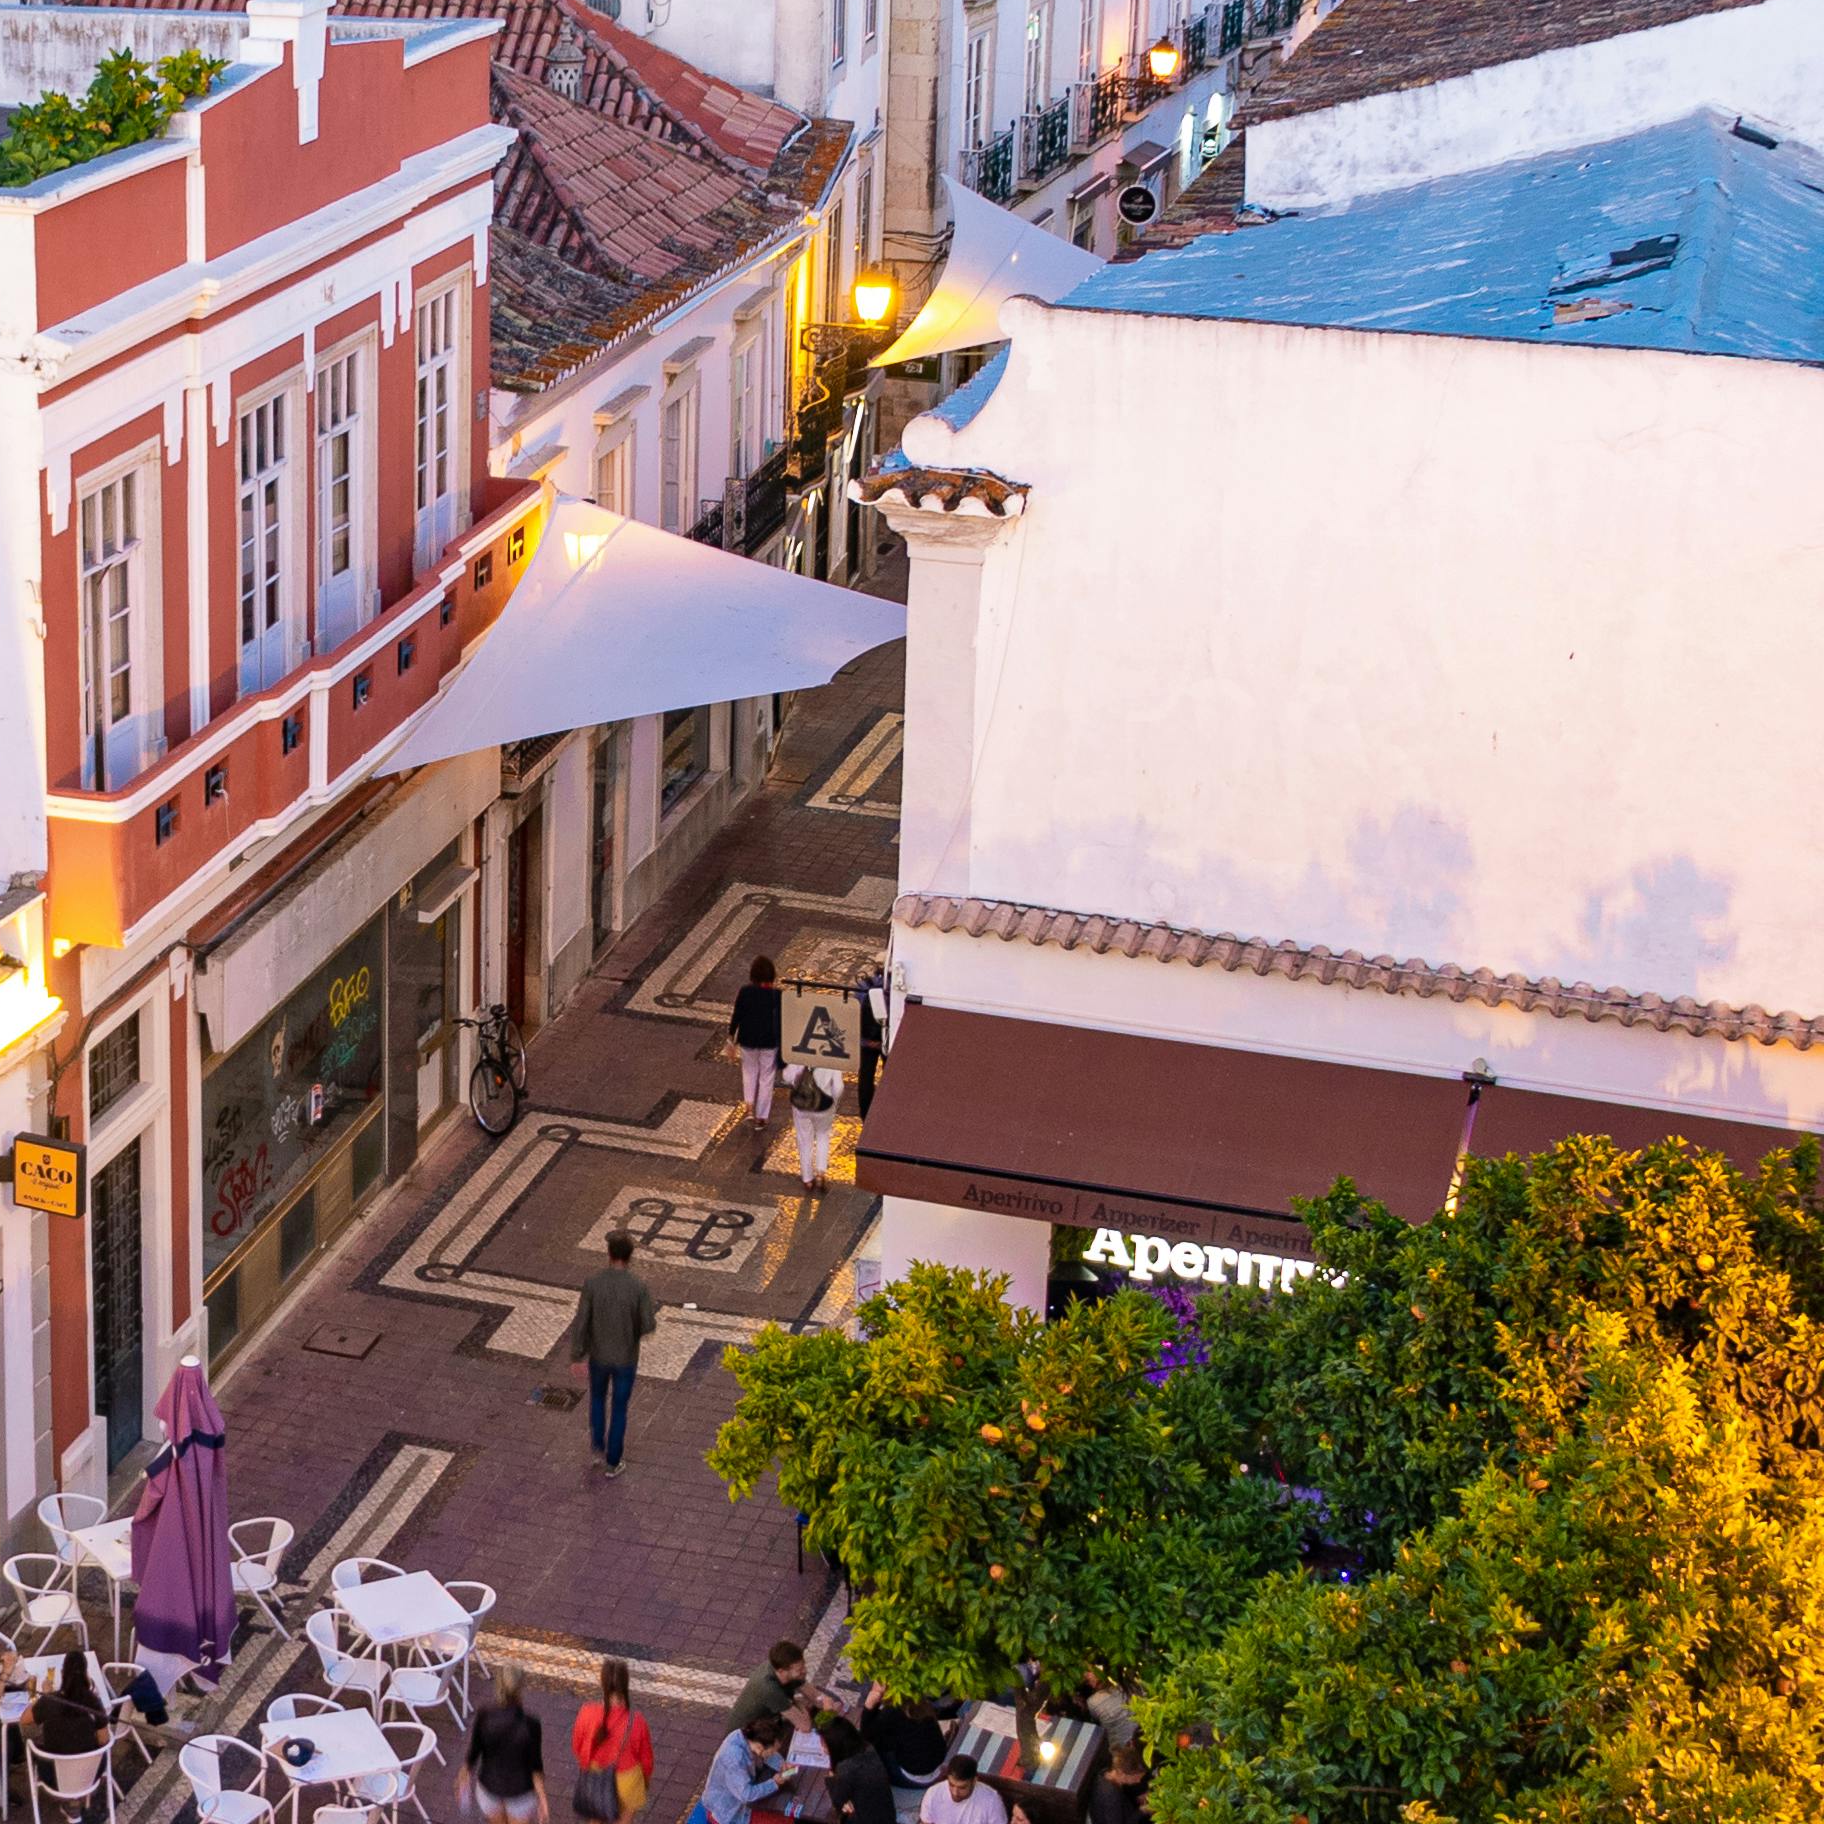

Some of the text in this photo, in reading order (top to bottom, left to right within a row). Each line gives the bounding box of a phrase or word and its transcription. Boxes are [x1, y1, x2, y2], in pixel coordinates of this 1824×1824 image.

[791, 1006, 850, 1059] A
[21, 1161, 73, 1184] CACO
[962, 1183, 1064, 1216] Aperitivo
